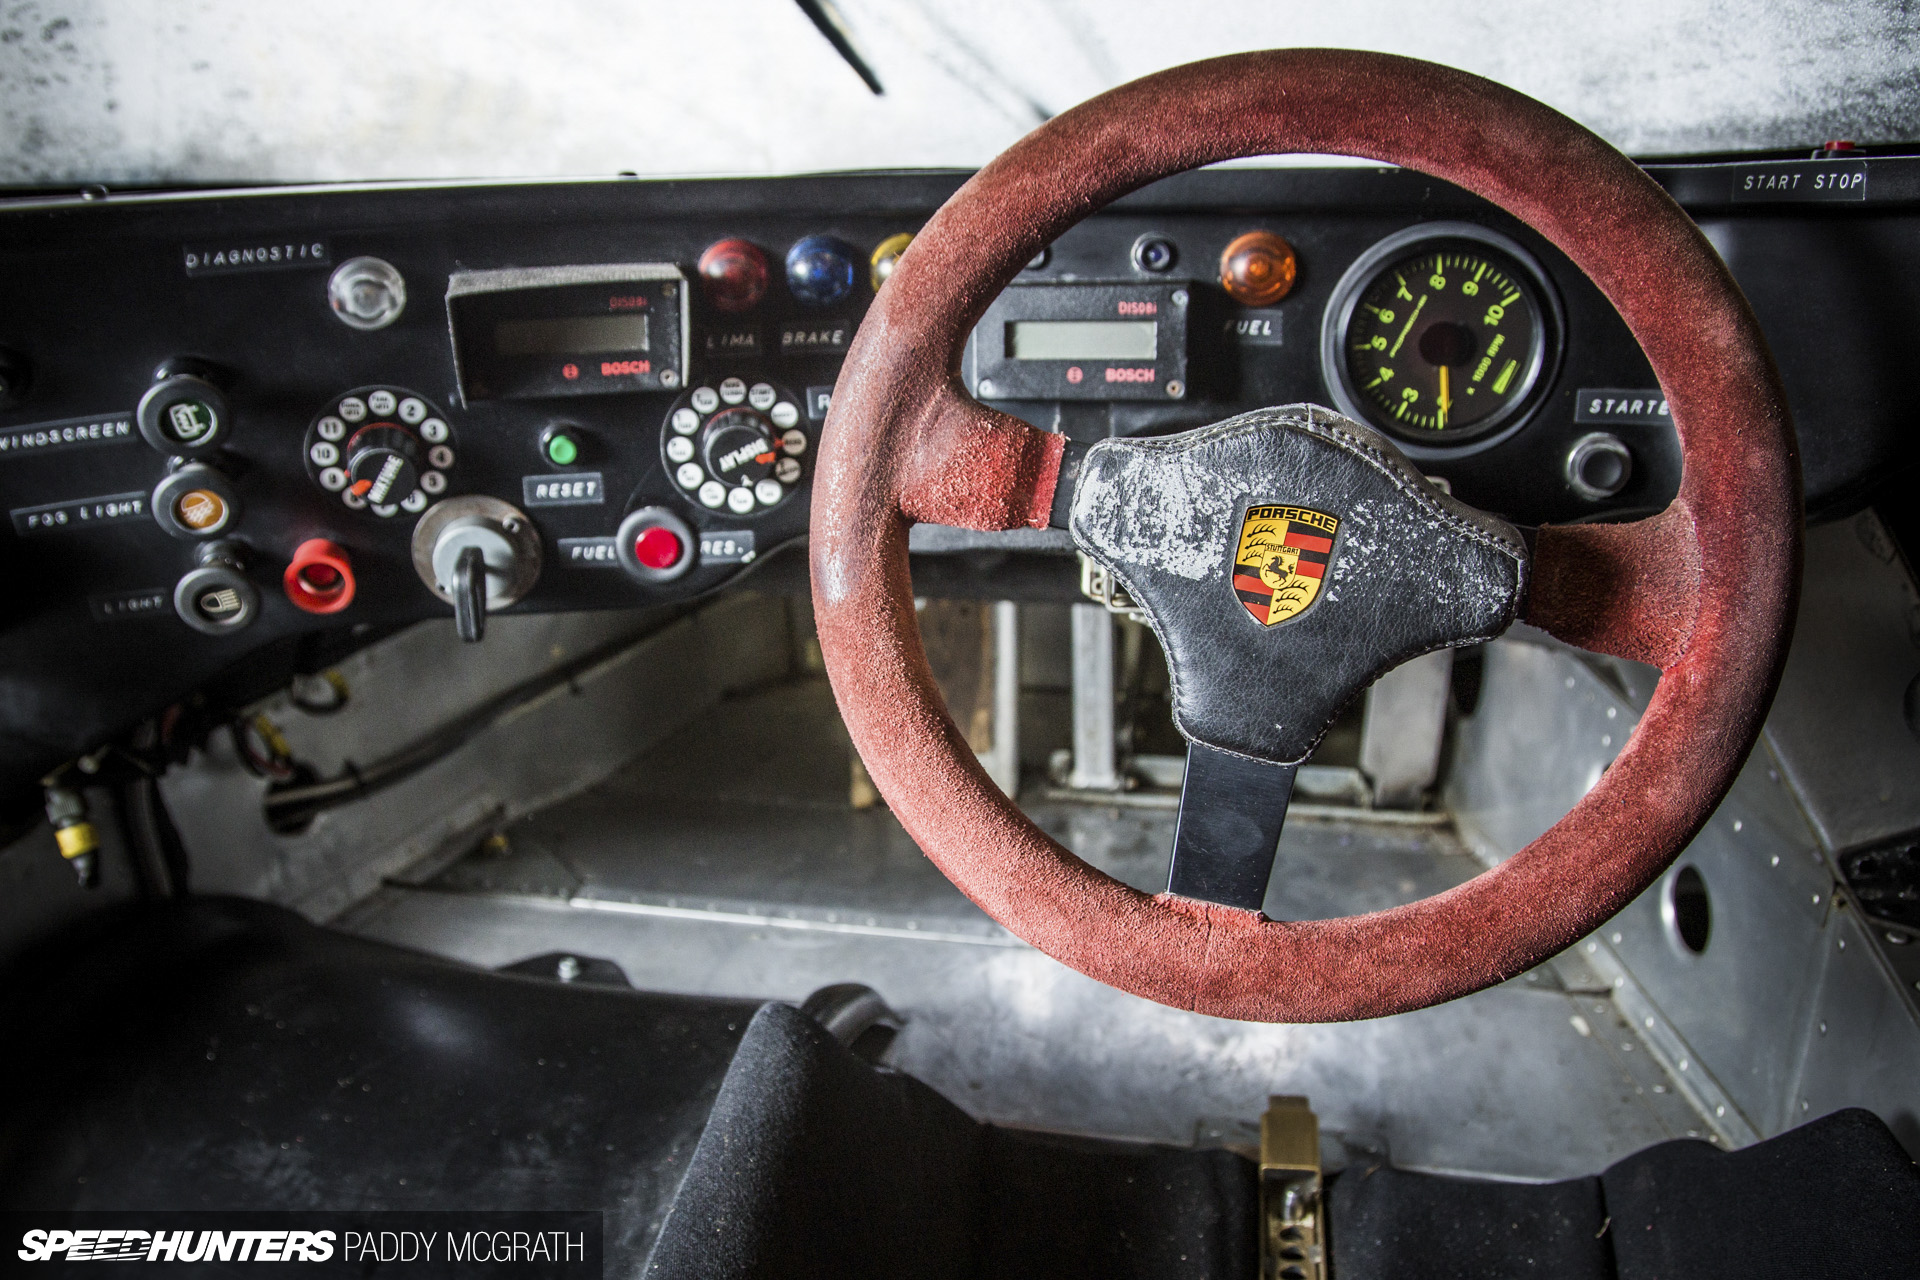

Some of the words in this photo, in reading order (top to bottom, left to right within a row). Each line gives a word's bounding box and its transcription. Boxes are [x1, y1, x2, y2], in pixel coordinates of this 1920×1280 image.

[1744, 174, 1800, 190] START
[1814, 173, 1863, 189] STOP
[186, 243, 324, 268] DIAGNOSTIC
[1429, 274, 1446, 290] 8
[1462, 280, 1479, 296] 9
[1396, 286, 1413, 301] 7
[1378, 308, 1395, 324] 6
[1483, 304, 1505, 326] 10
[781, 329, 844, 346] BRAKE
[1371, 335, 1387, 351] 5
[601, 359, 651, 376] BOSCH
[1105, 367, 1155, 382] BOSCH
[1379, 366, 1395, 382] 4
[1402, 387, 1419, 403] 3
[1589, 399, 1669, 415] STARTE
[324, 421, 338, 434] 11
[0, 421, 130, 451] WINDSCREEN
[536, 481, 597, 499] RESET
[28, 511, 68, 528] FOG
[80, 500, 142, 520] LIGHT
[1247, 507, 1336, 532] PORSCHE
[571, 545, 615, 560] FUEL
[1265, 543, 1300, 555] STUTTGART
[104, 595, 162, 614] LIGHT
